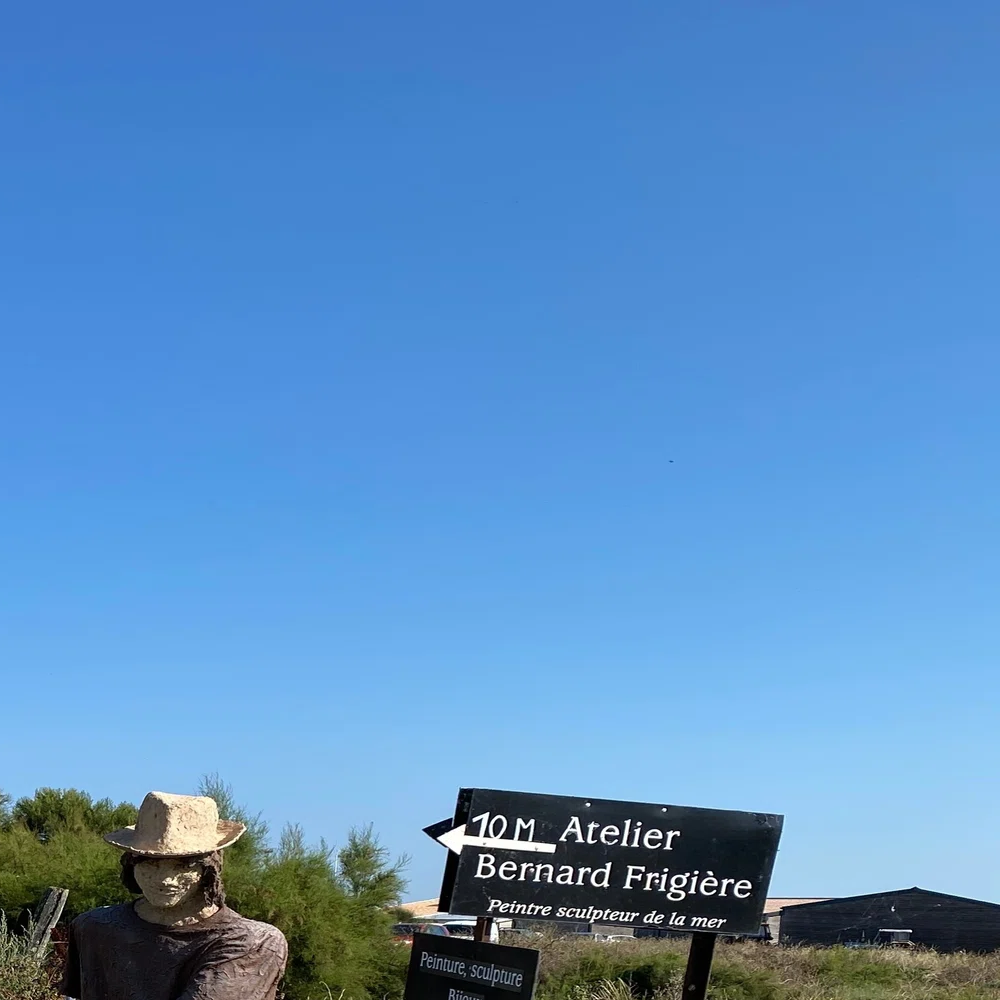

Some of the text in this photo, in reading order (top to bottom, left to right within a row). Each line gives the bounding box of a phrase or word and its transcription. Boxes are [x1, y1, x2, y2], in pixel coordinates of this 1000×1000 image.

[472, 811, 536, 842] 10 M
[558, 815, 681, 851] Atelier
[473, 853, 753, 901] Bernard Frigière
[486, 899, 728, 930] Peintre sculpteur de la mer
[419, 951, 524, 987] Peinture, sculpture
